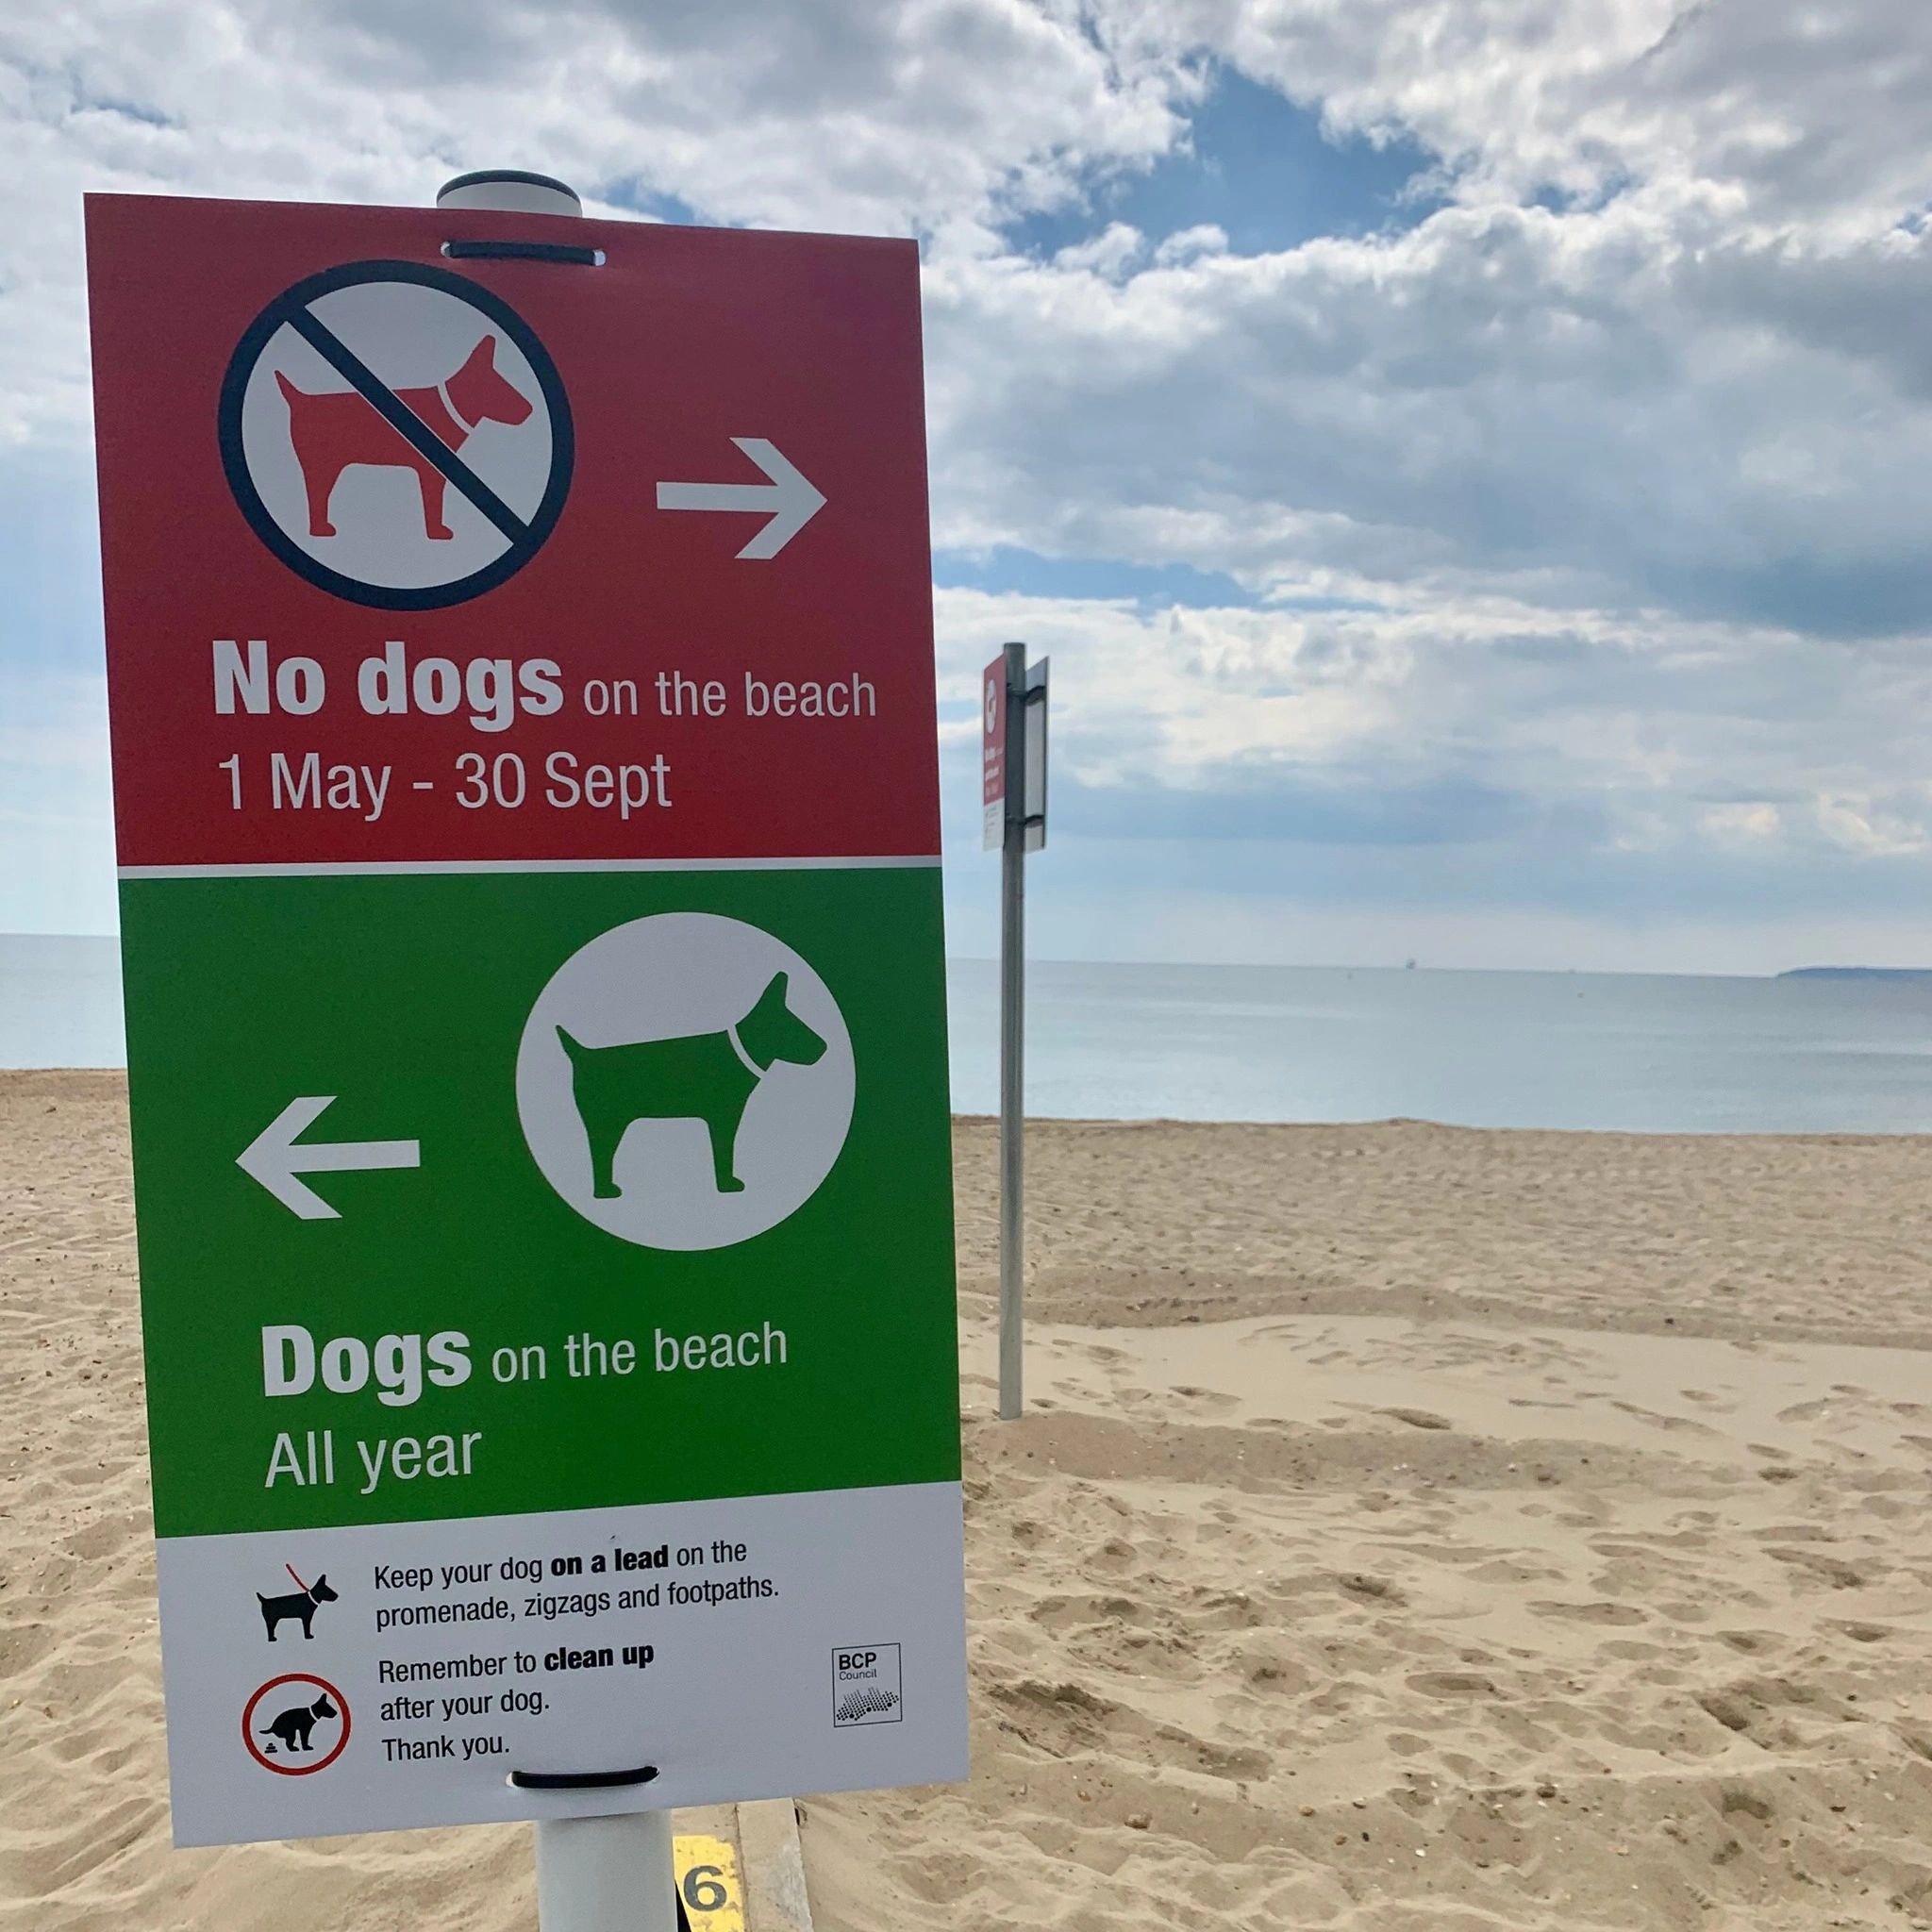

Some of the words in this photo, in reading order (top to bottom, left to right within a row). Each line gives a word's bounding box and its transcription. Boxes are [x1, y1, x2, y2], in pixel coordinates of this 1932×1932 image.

[212, 640, 325, 715] No
[358, 641, 564, 733] dogs
[584, 679, 638, 715] on
[655, 671, 726, 716] the
[745, 671, 875, 717] beach
[219, 754, 242, 809] 1
[271, 752, 391, 822] May
[456, 753, 525, 808] 30
[545, 751, 672, 820] Sept
[261, 1324, 472, 1407] Dogs
[492, 1346, 545, 1382] on
[564, 1333, 635, 1377] the
[655, 1322, 787, 1372] beach
[265, 1429, 334, 1488] All
[357, 1432, 482, 1494] year
[375, 1565, 434, 1592] Keep
[441, 1563, 493, 1591] your
[500, 1556, 542, 1584] dog
[550, 1556, 583, 1577] on
[591, 1554, 607, 1574] a
[614, 1544, 669, 1572] lead
[676, 1546, 704, 1567] on
[710, 1540, 747, 1564] the
[376, 1596, 515, 1633] promenade,
[524, 1591, 610, 1621] zigzags
[618, 1583, 660, 1609] and
[666, 1574, 779, 1607] footpaths.
[378, 1654, 508, 1684] Remember
[513, 1651, 537, 1674] to
[543, 1646, 614, 1672] clean
[622, 1644, 655, 1670] up
[839, 1652, 876, 1670] BCP
[839, 1669, 877, 1681] Council
[380, 1696, 435, 1722] after
[441, 1694, 493, 1723] your
[500, 1689, 550, 1716] dog.
[381, 1735, 456, 1762] Thank
[461, 1736, 509, 1761] you.
[683, 1865, 727, 1912] 6
